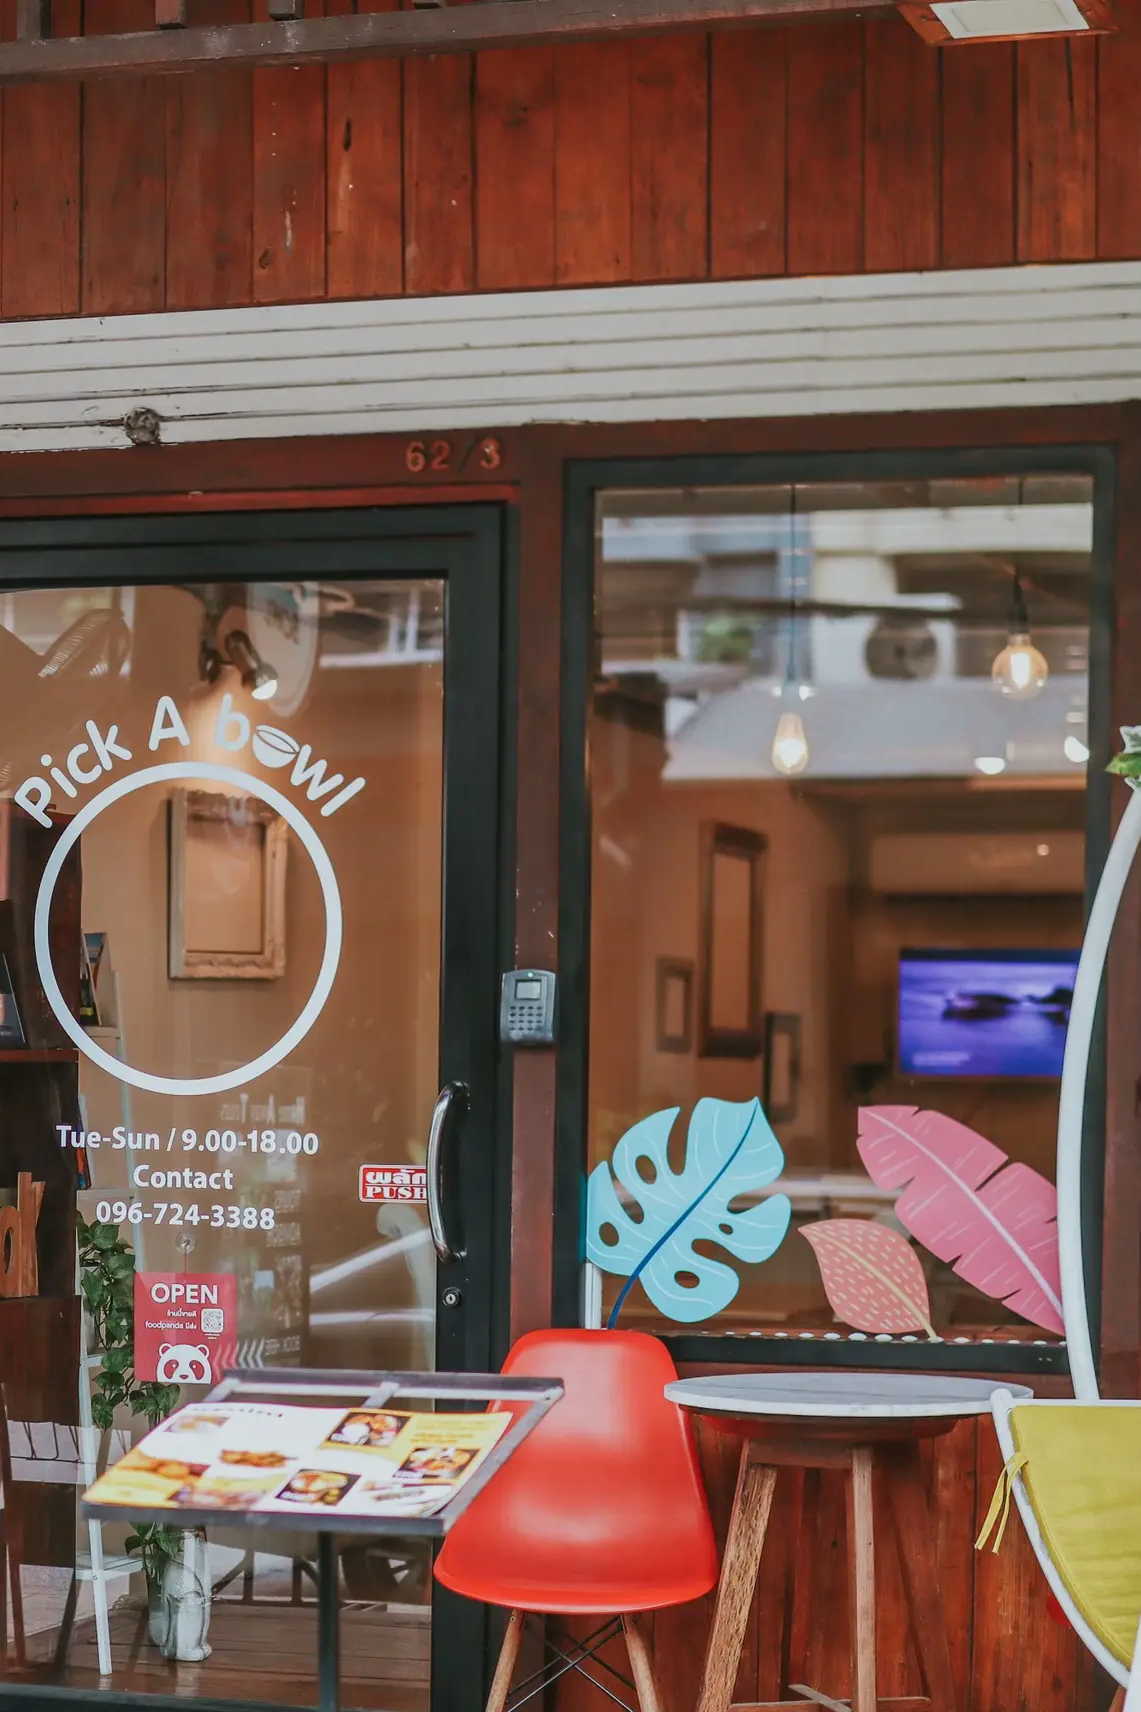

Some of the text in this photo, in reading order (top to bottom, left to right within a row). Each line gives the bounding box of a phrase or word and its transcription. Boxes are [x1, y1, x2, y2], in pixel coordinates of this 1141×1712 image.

[13, 719, 133, 829] Pick
[148, 695, 190, 751] A
[56, 1124, 160, 1151] Tue-Sun
[181, 1128, 319, 1156] 9.00-18.00
[133, 1163, 234, 1190] Contact
[365, 1186, 426, 1199] PUSH
[95, 1201, 276, 1230] 096-724-3388
[151, 1283, 218, 1304] OPEN
[145, 1320, 184, 1330] foodpanda
